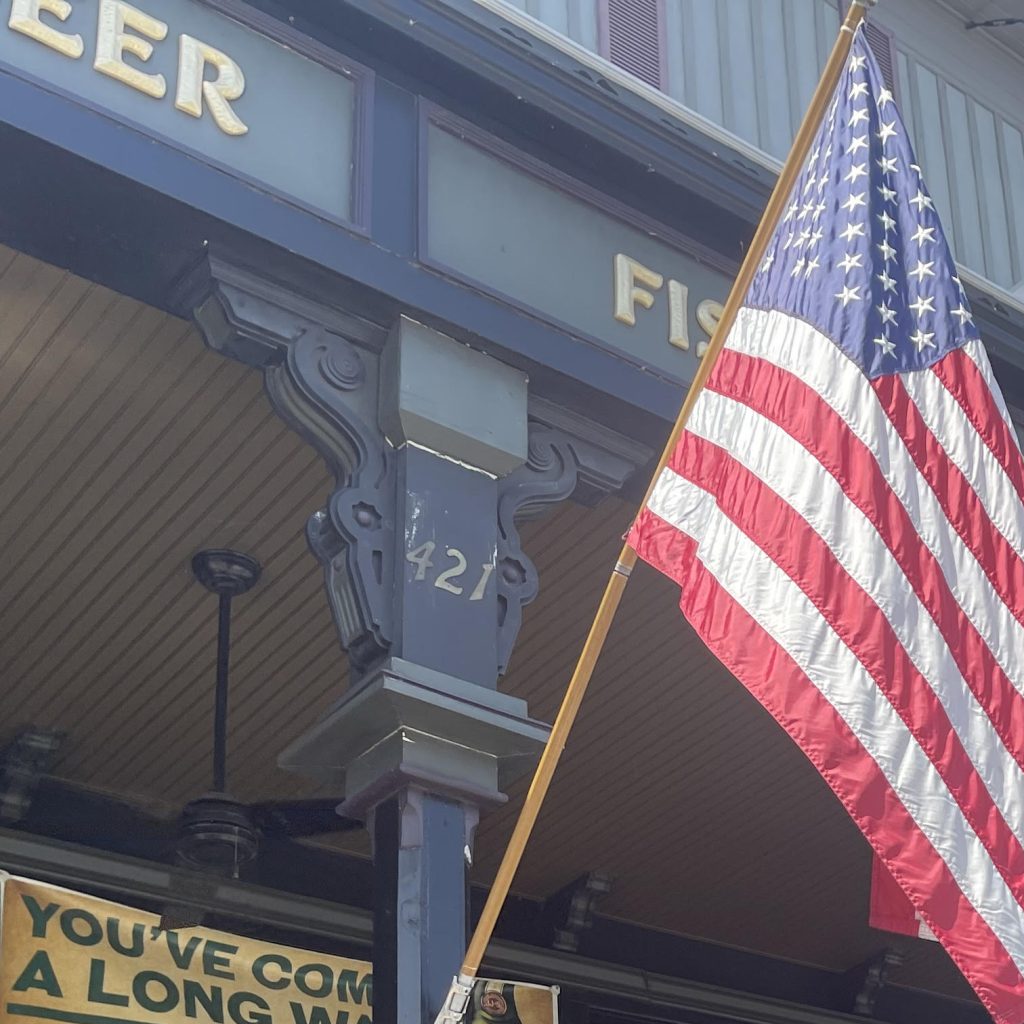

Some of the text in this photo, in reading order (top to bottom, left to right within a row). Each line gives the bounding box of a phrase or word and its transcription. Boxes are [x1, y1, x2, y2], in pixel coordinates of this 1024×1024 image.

[406, 541, 495, 601] 421
[20, 893, 239, 981] YOU'VE
[12, 950, 64, 998] A
